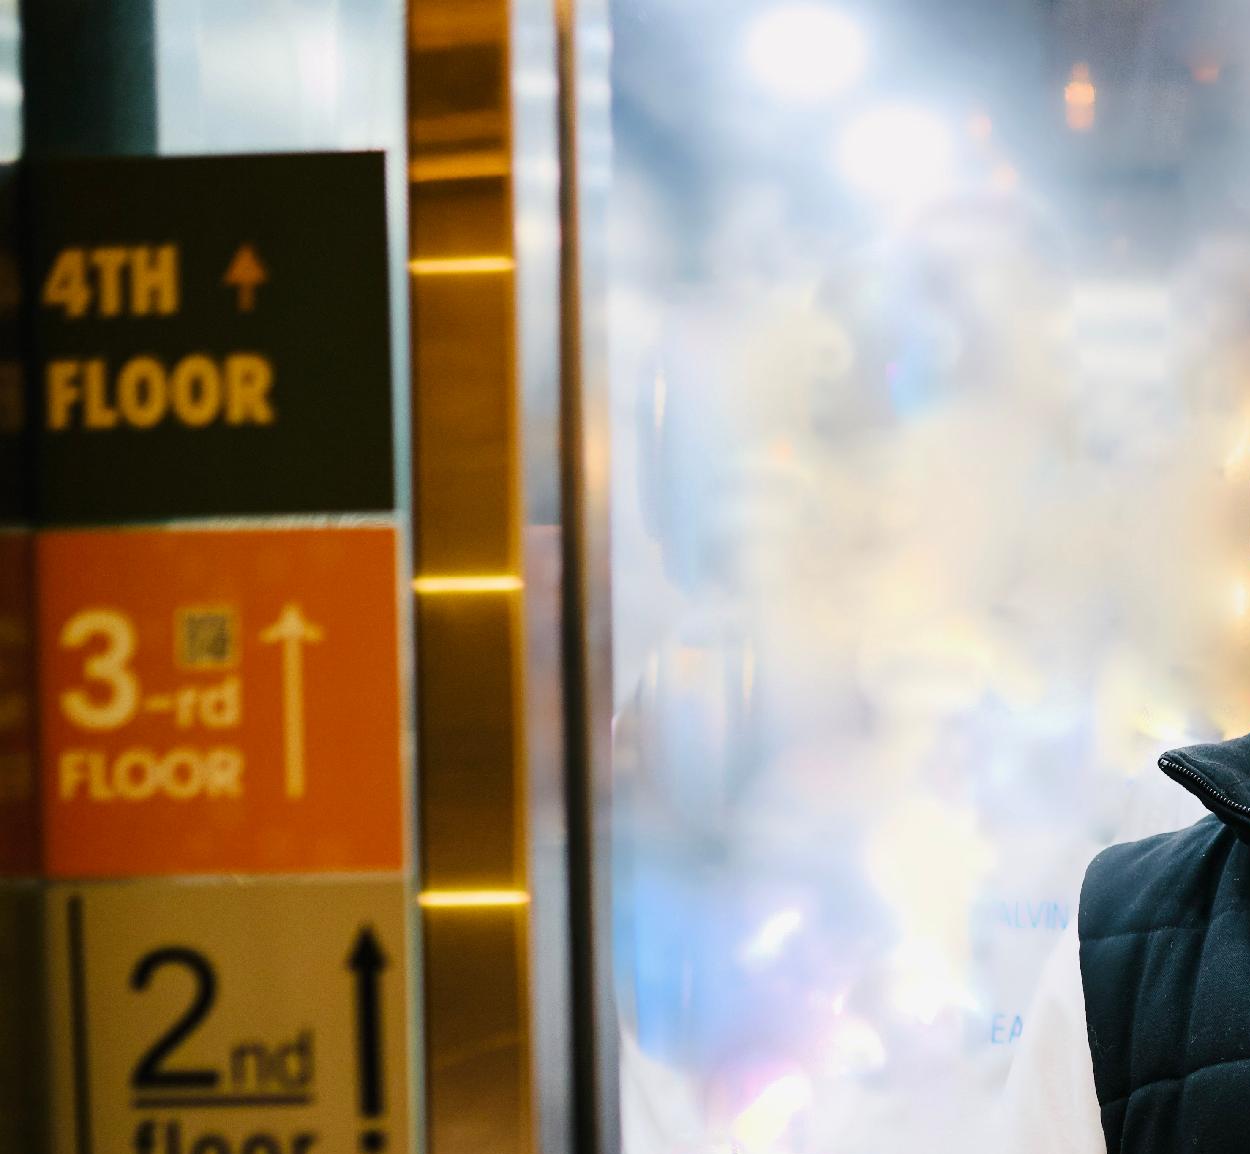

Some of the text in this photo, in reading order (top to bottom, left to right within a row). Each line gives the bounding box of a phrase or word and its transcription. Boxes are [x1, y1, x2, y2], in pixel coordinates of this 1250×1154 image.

[43, 243, 180, 319] 4TH
[45, 353, 276, 431] FLOOR
[58, 746, 243, 800] FLOOR
[130, 943, 315, 1090] 2nd
